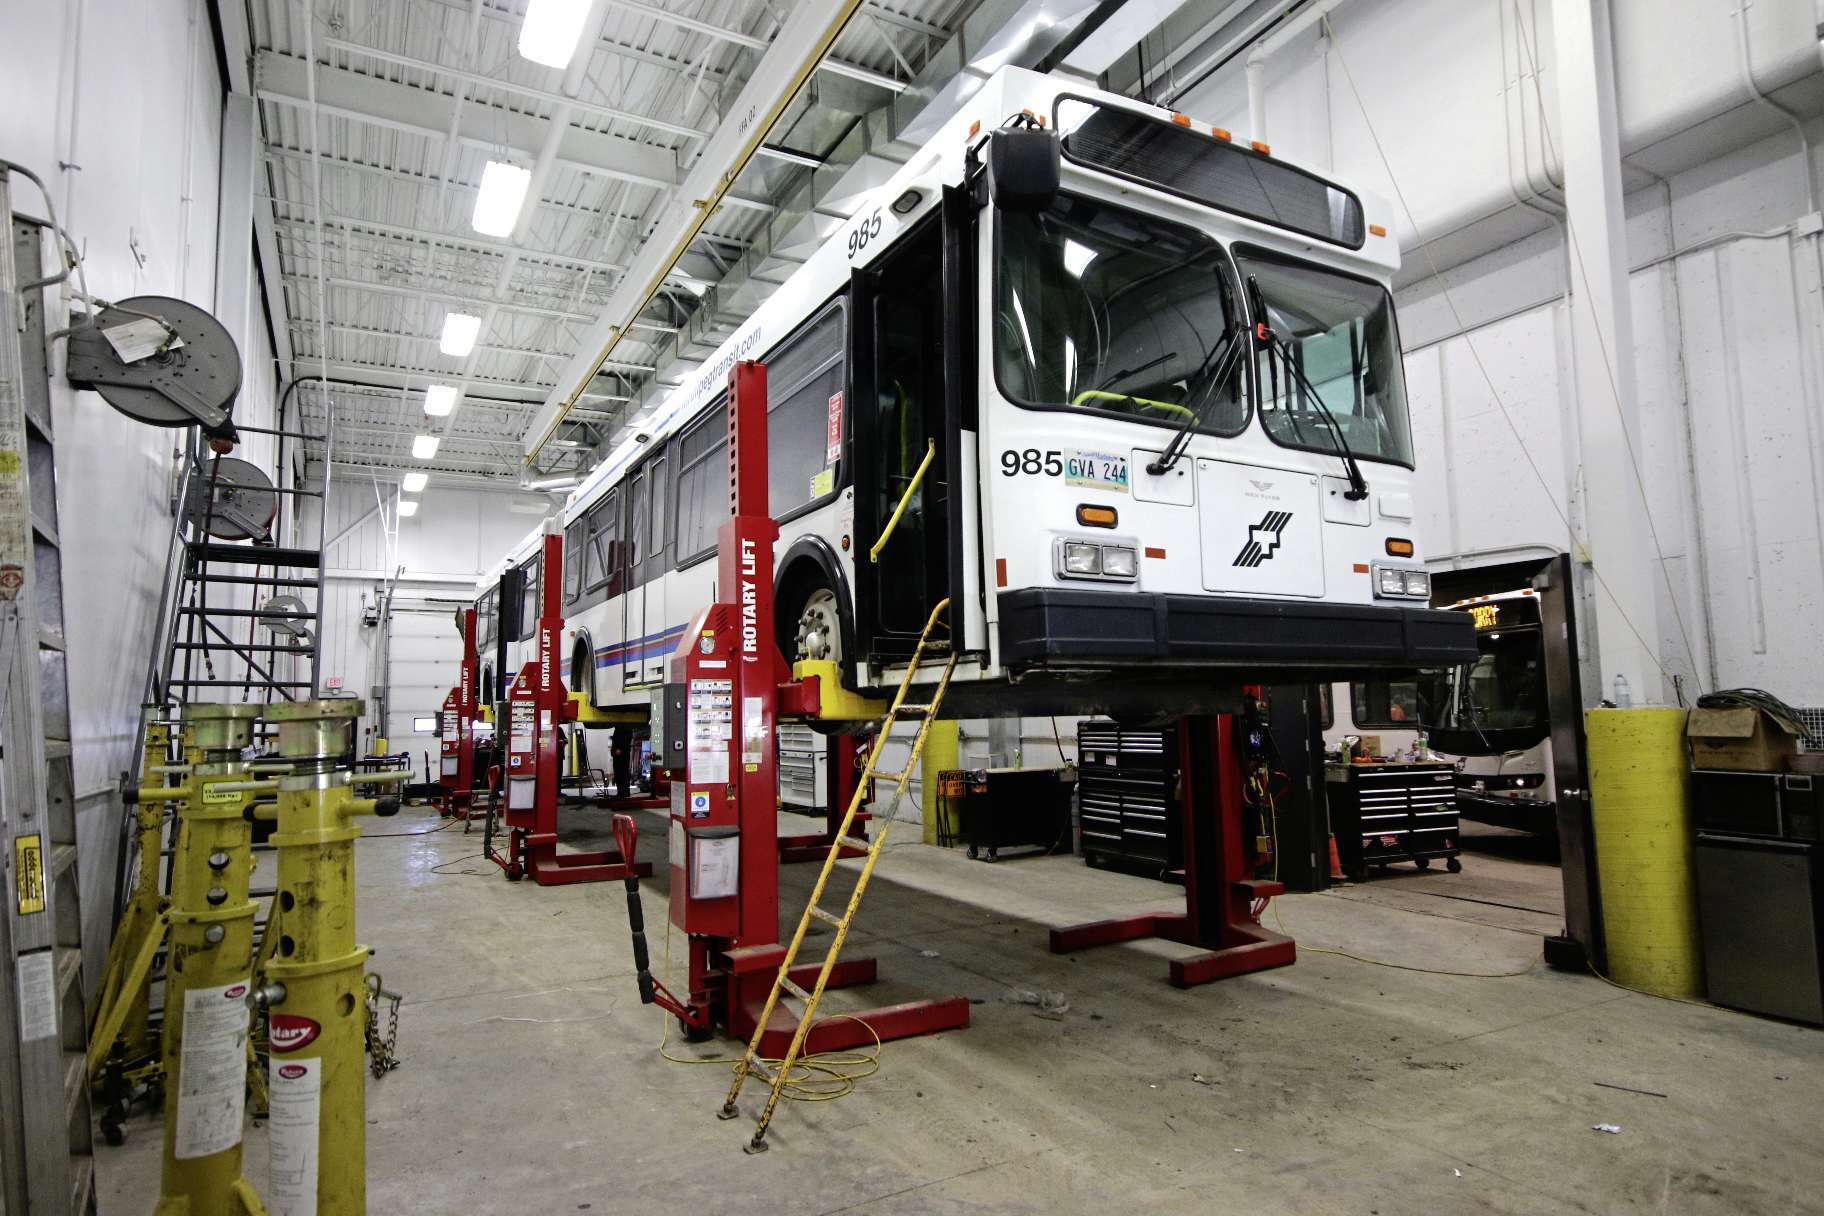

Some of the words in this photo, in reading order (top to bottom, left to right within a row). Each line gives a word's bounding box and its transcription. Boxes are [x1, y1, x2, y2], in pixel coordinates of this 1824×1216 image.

[848, 206, 882, 259] 985
[1001, 448, 1063, 477] 985
[1069, 458, 1095, 478] GVA
[1103, 462, 1127, 483] 244
[741, 538, 756, 576] LIFT
[742, 580, 757, 652] ROTARY
[541, 628, 551, 649] LIFT
[541, 650, 551, 687] ROTARY
